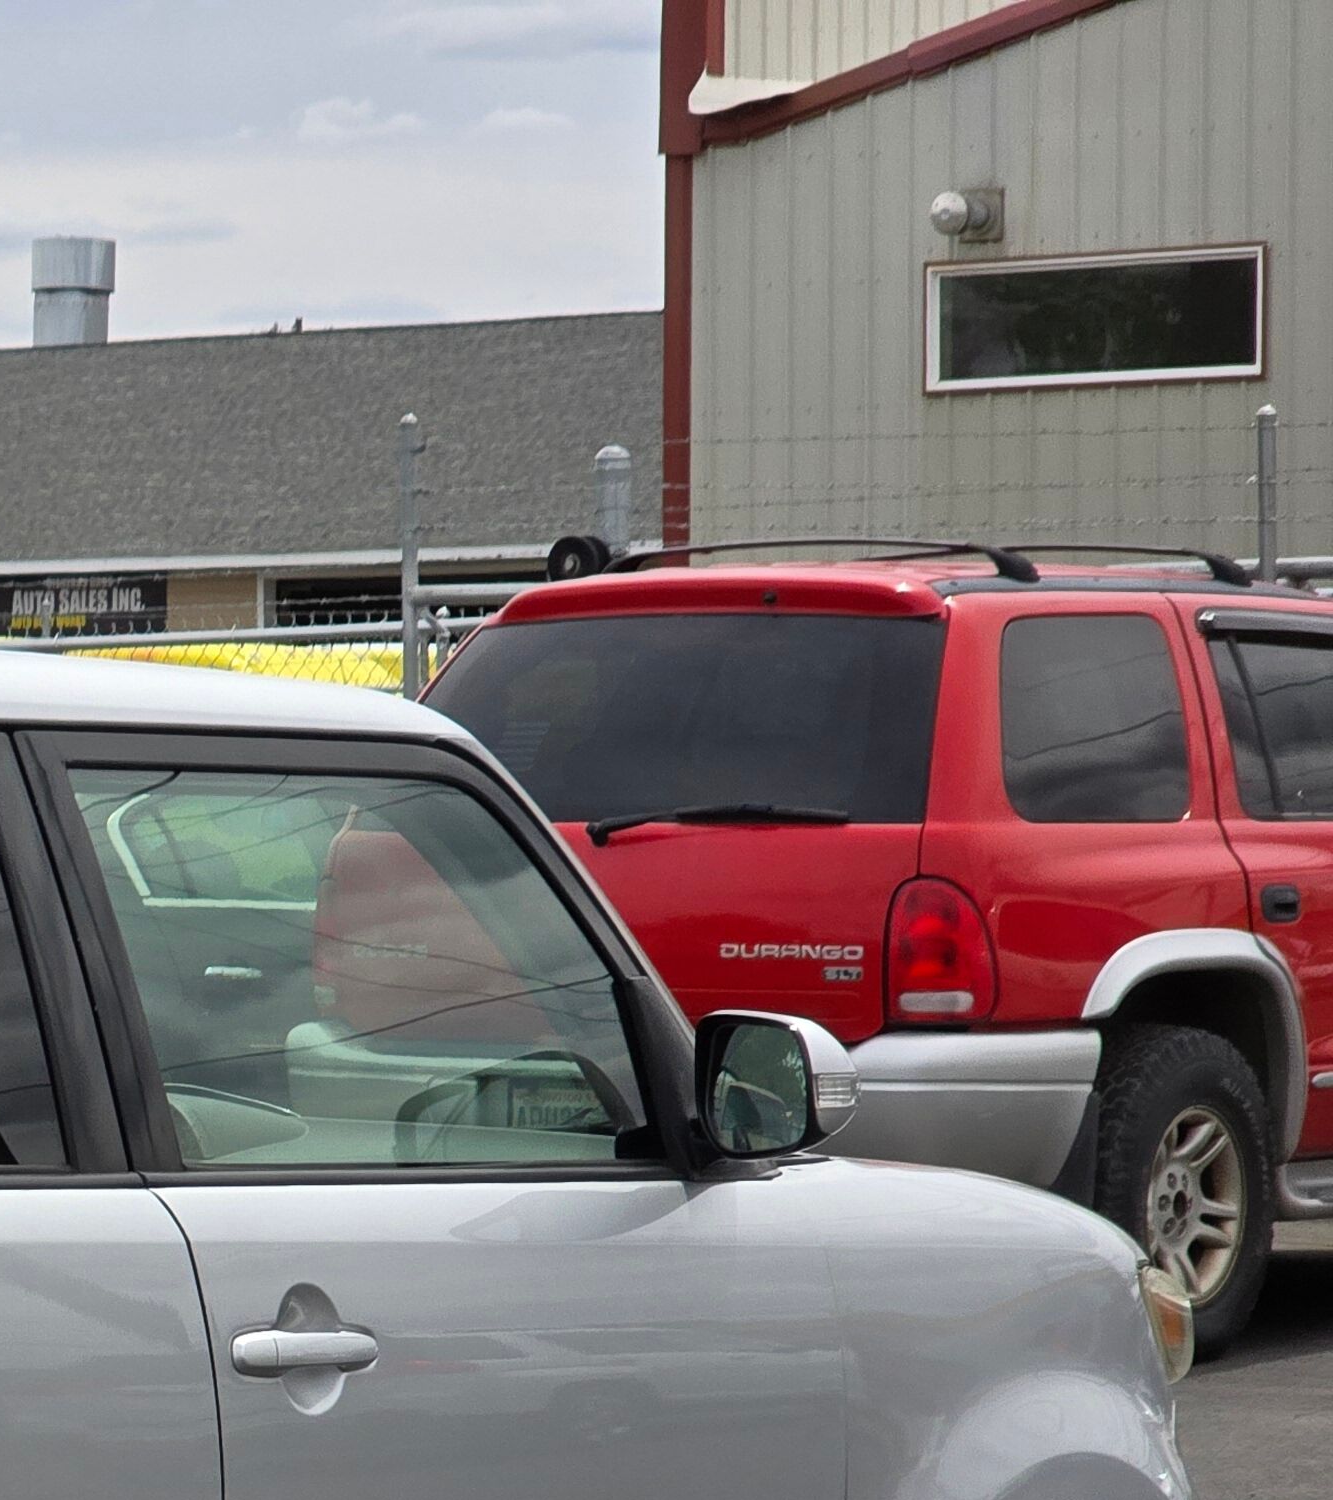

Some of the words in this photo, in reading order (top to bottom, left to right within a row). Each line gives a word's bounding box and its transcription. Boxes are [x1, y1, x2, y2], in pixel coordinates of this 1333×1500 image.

[59, 588, 108, 613] SALES
[112, 587, 146, 612] INC.
[720, 942, 864, 960] DURANGO
